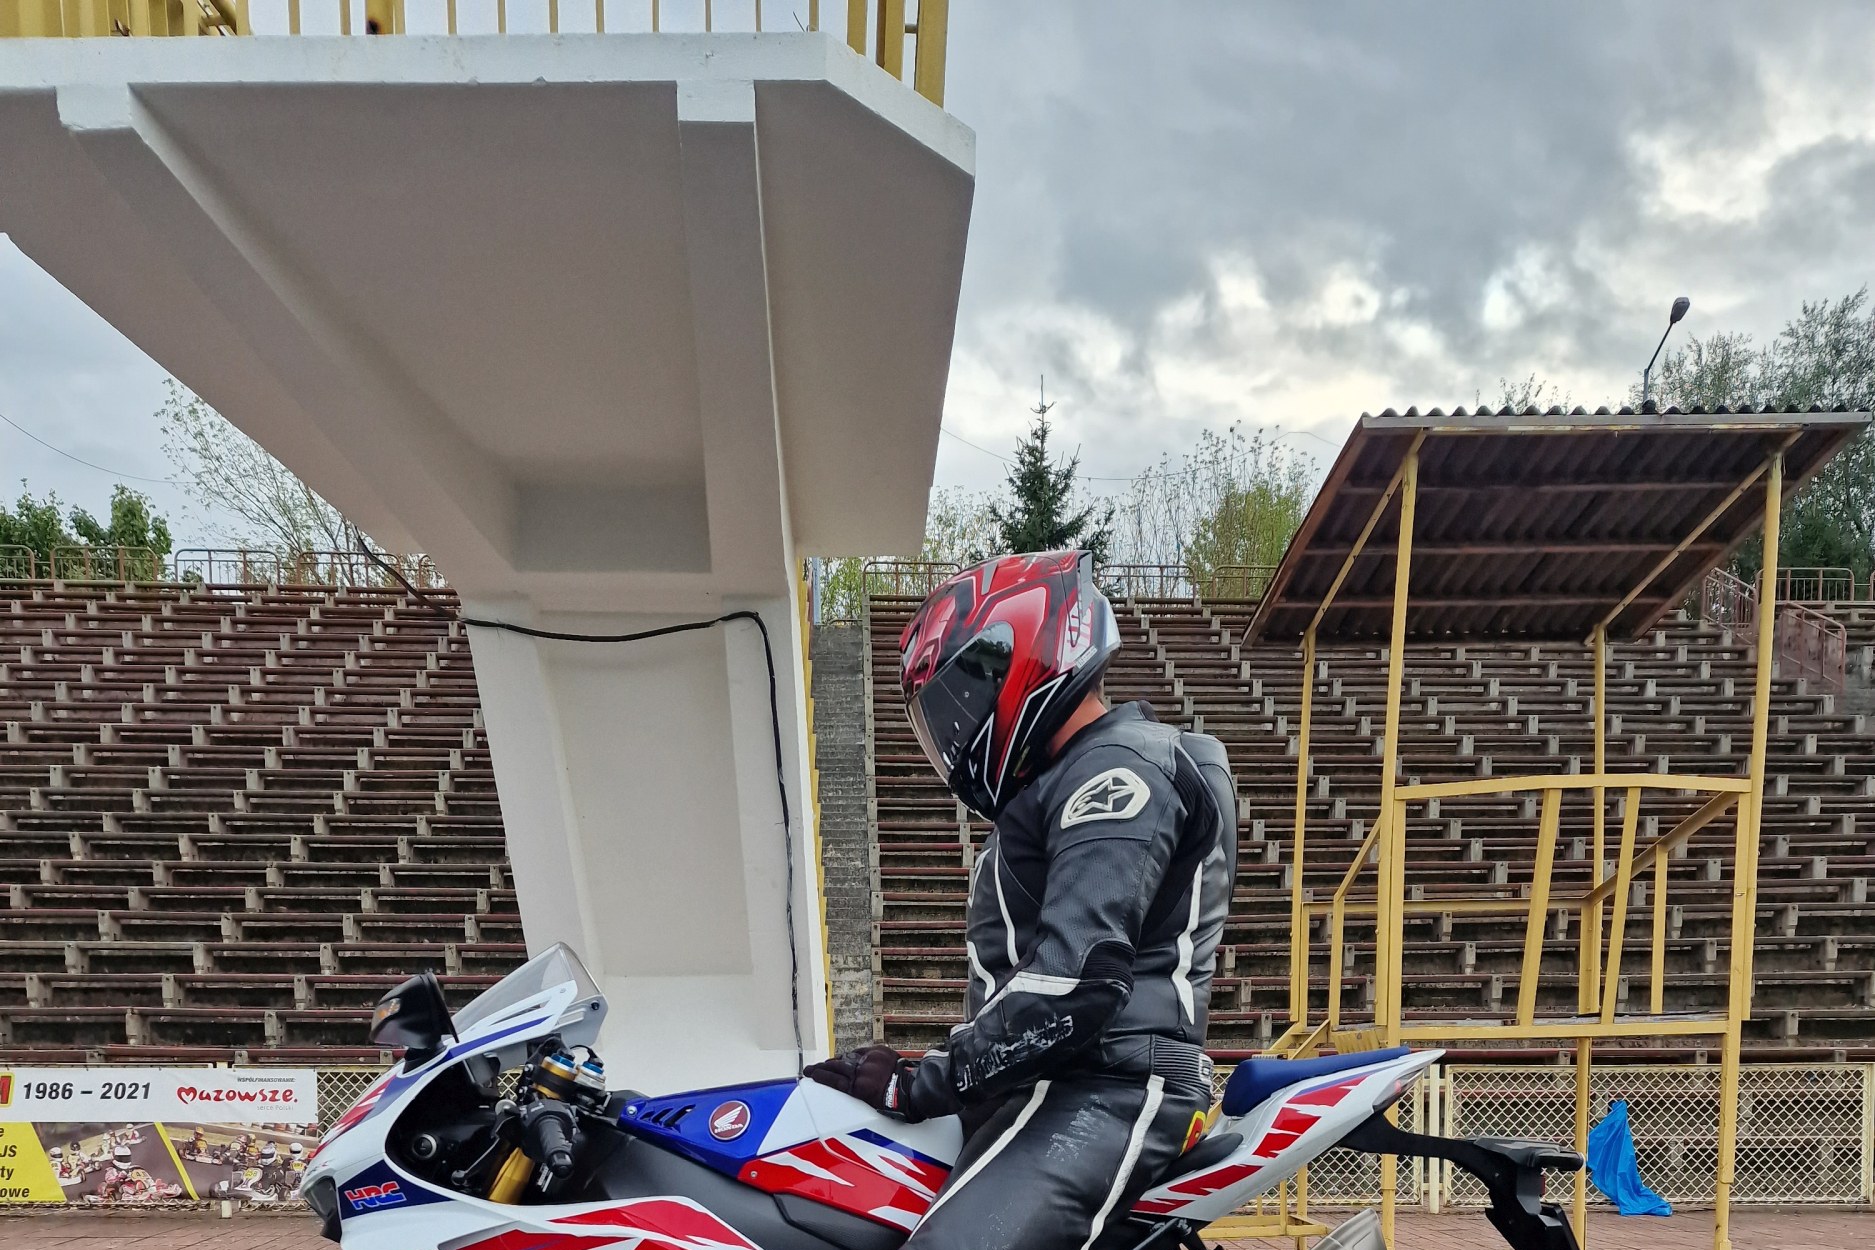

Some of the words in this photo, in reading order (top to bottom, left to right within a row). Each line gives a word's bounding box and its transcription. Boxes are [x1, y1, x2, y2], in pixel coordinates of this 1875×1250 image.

[23, 1082, 74, 1100] 1986
[100, 1082, 152, 1100] 2021
[344, 1181, 407, 1210] HRC
